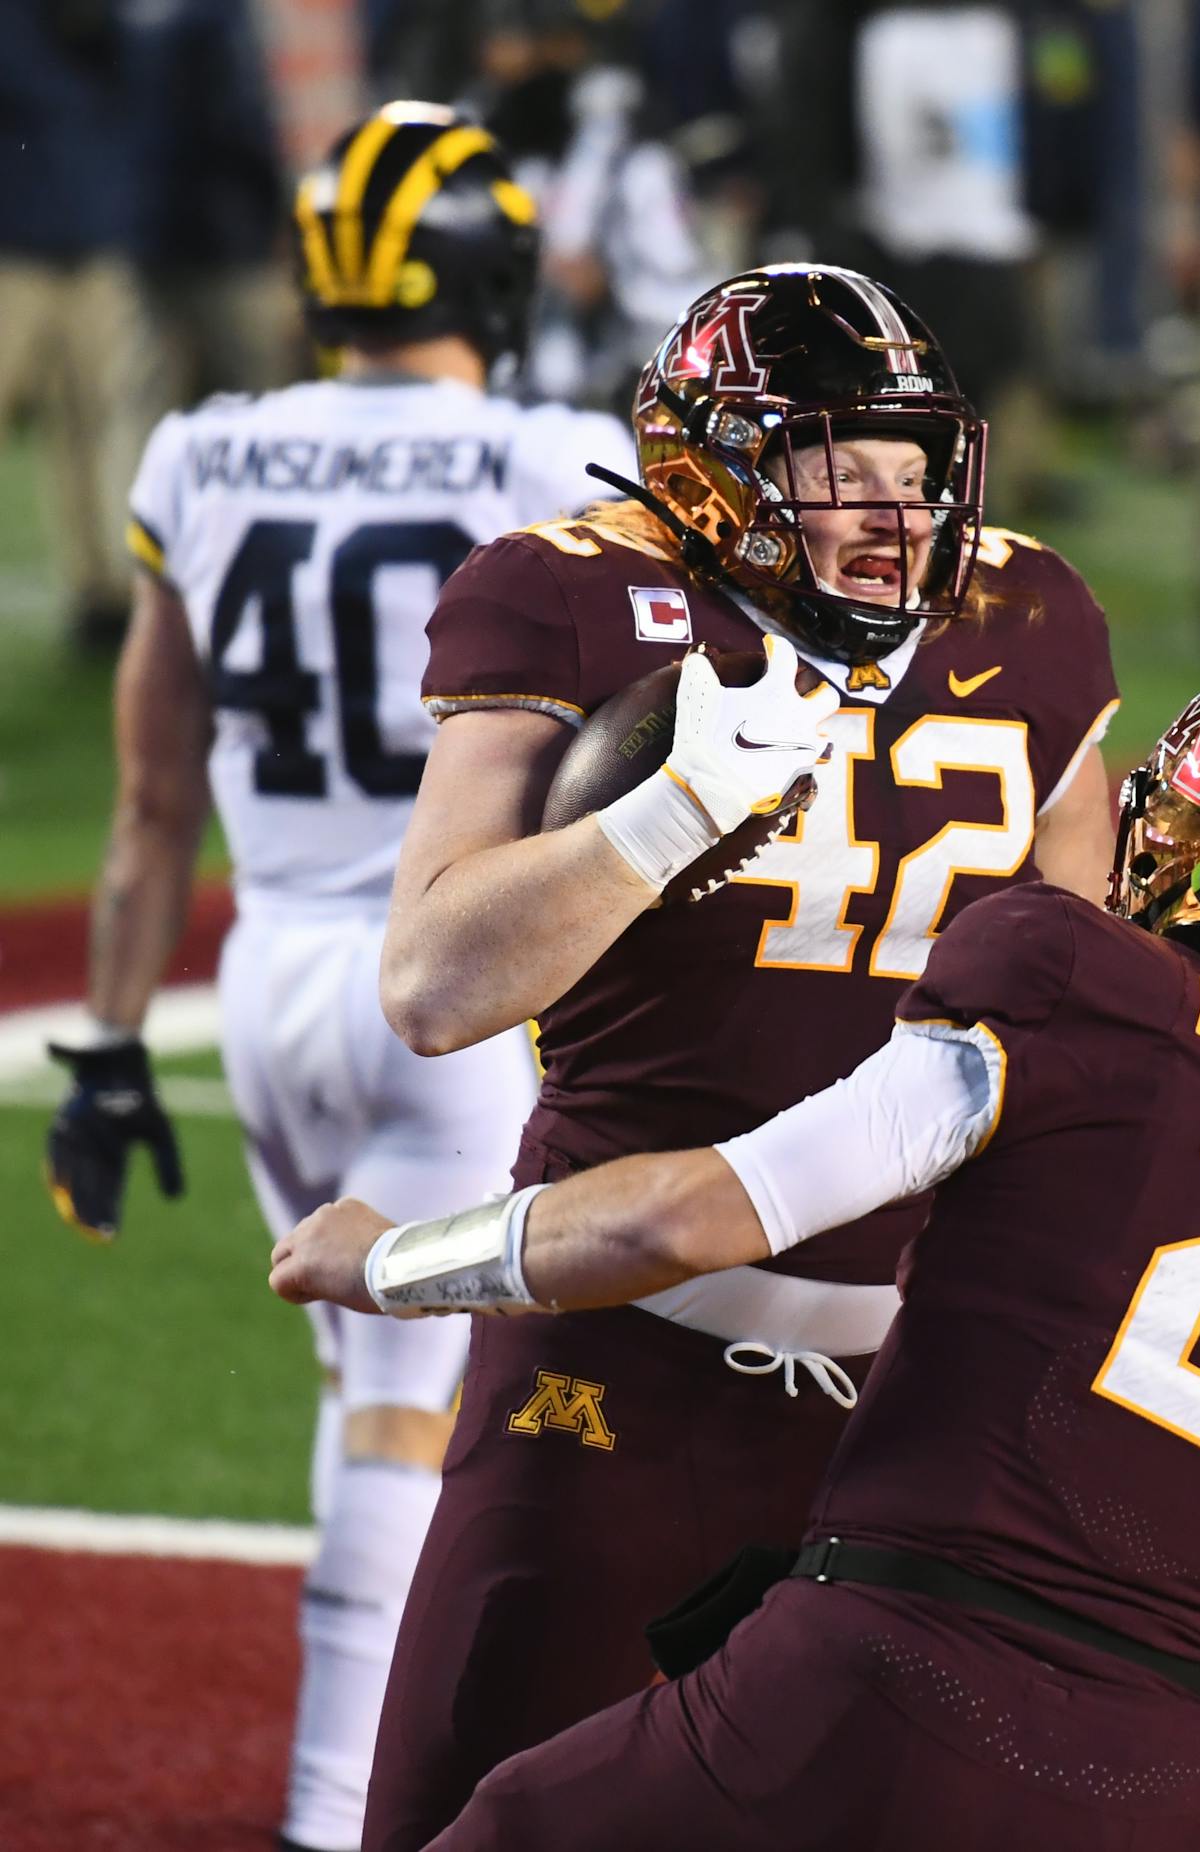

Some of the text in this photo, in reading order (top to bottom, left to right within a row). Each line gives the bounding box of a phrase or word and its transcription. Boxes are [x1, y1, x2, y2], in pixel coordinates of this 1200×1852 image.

[208, 519, 479, 796] 40
[631, 590, 689, 640] C
[731, 707, 1036, 982] 42
[507, 1370, 616, 1451] M
